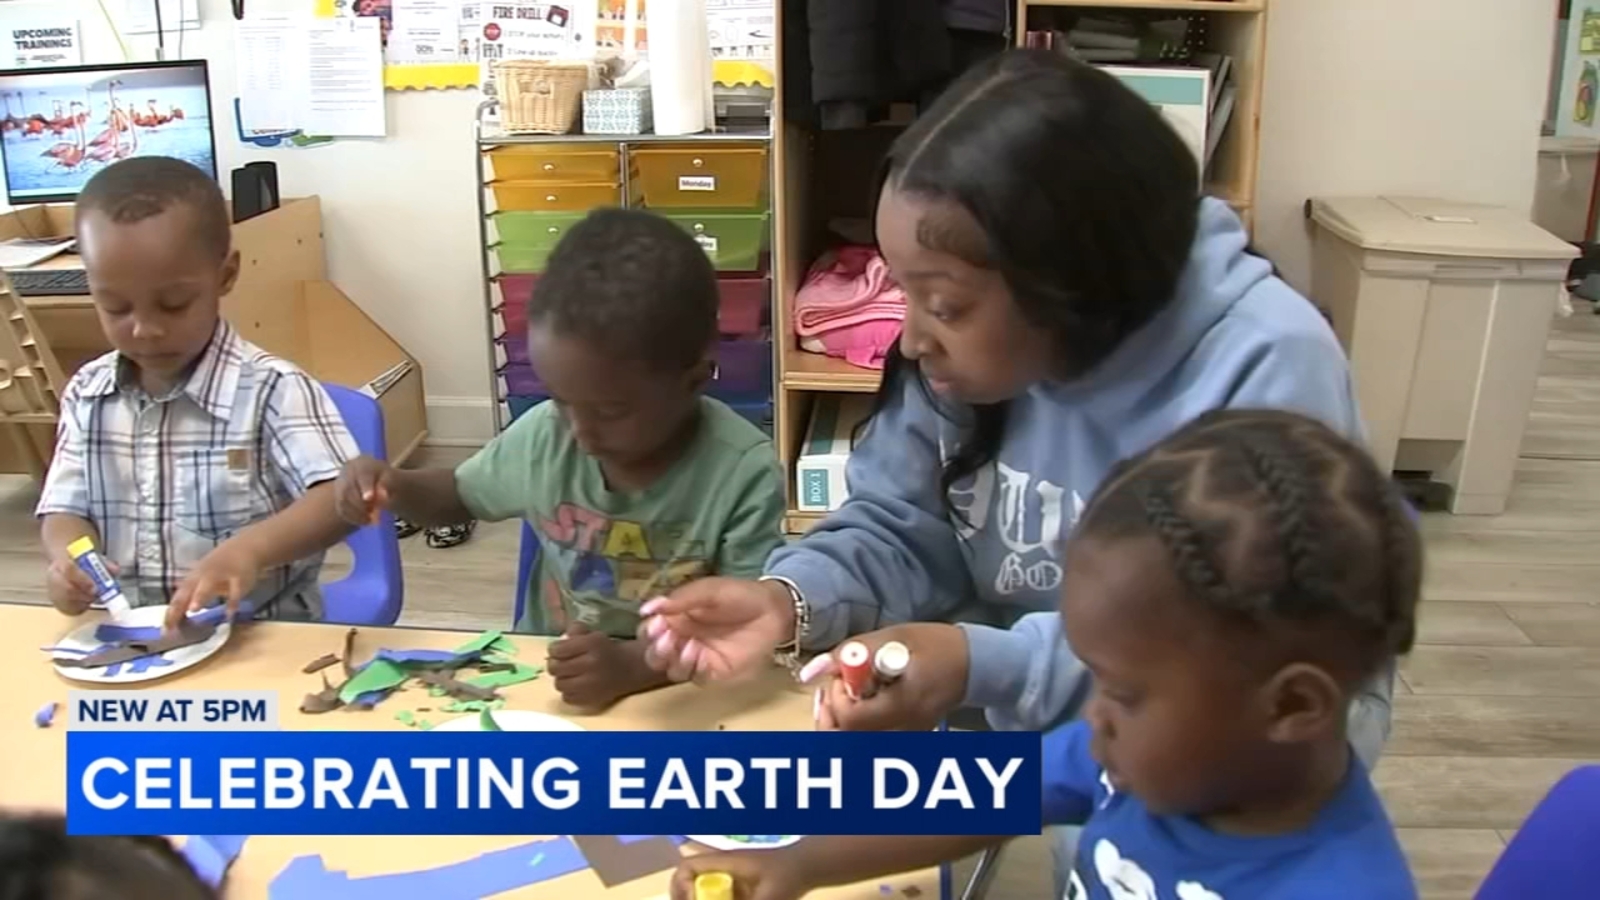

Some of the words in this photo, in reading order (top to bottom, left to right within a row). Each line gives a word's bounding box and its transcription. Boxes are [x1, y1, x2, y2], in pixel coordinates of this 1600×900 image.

[493, 6, 514, 19] FIRE
[516, 7, 541, 20] DRILL
[13, 27, 72, 39] UPCOMING
[15, 39, 72, 50] TRAININGS
[681, 180, 712, 188] Monday
[810, 481, 822, 502] BOX
